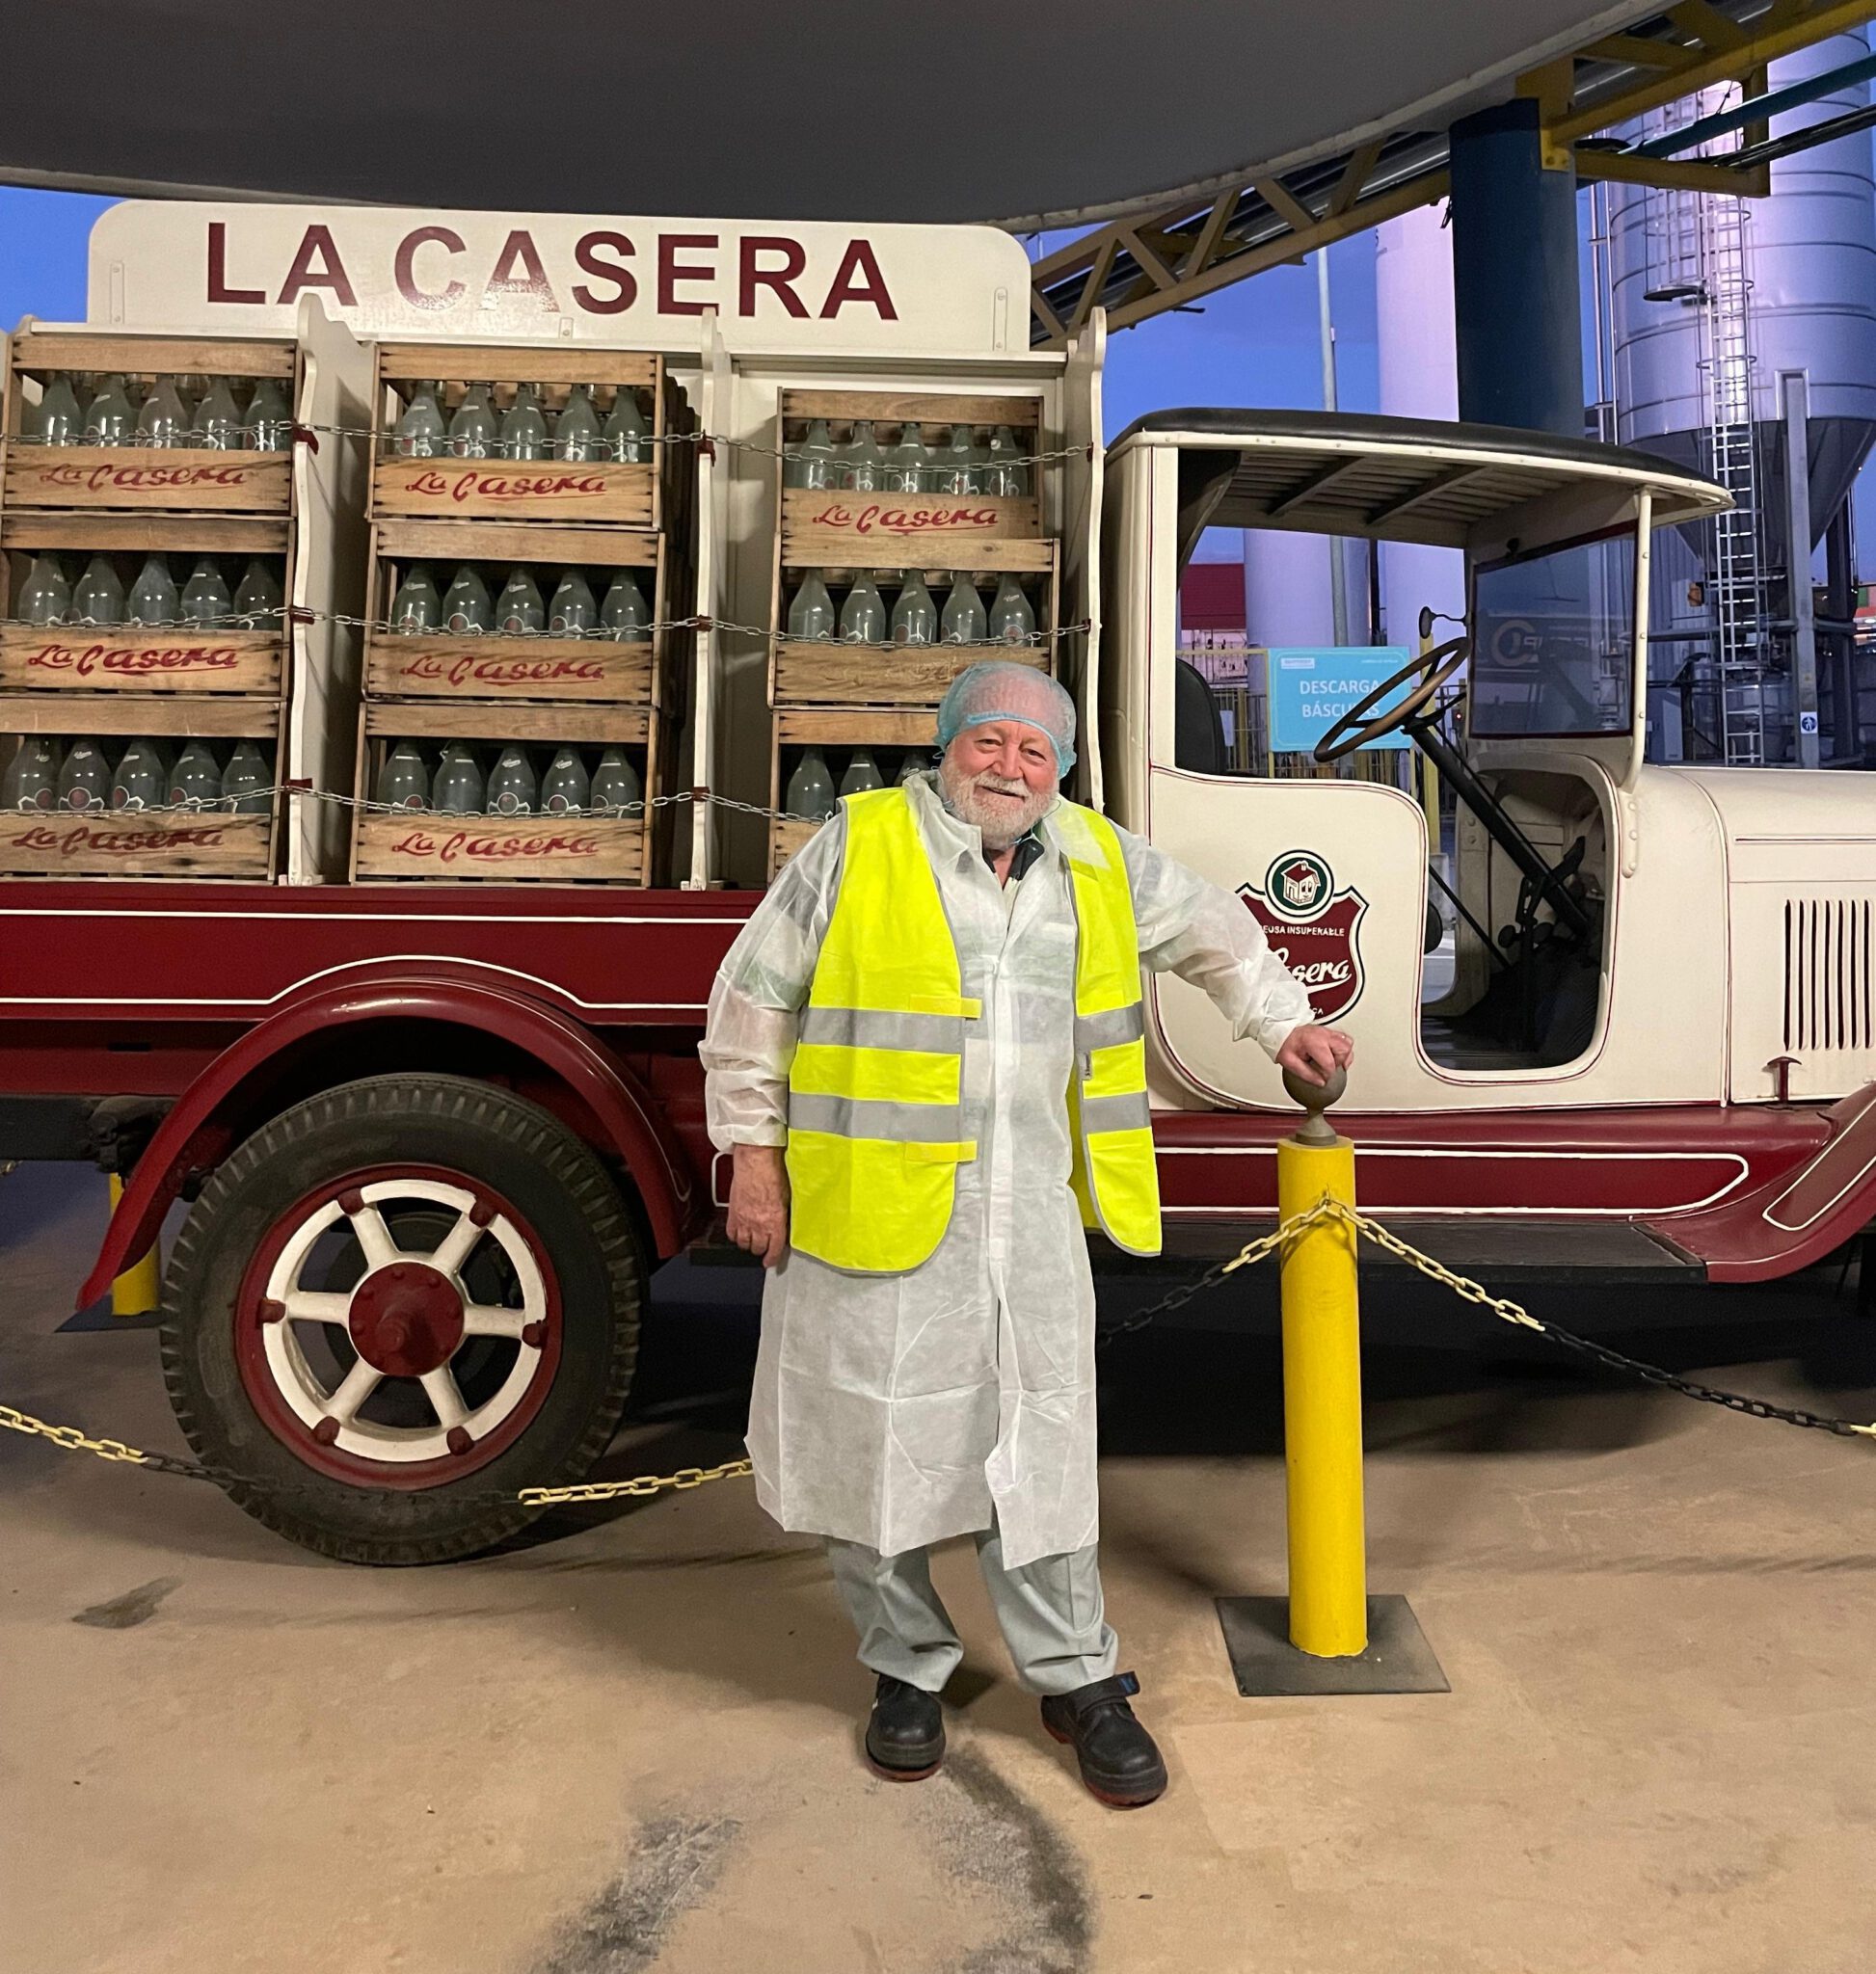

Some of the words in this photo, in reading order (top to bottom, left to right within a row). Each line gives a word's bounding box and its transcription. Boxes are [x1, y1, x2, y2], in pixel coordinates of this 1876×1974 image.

[207, 222, 359, 307] LA
[394, 226, 898, 320] CASERA
[40, 463, 81, 483] La
[87, 464, 247, 493] Casera
[405, 471, 446, 495] La
[452, 472, 607, 503] Casera
[813, 504, 853, 527] La
[856, 505, 999, 536] Casera
[28, 644, 74, 669] La
[76, 644, 240, 677] Casera
[399, 654, 443, 680] La
[447, 655, 605, 686] Casera
[12, 826, 59, 851] La
[60, 826, 225, 857] Casera
[390, 832, 437, 857] La
[439, 832, 601, 864] Casera
[1287, 926, 1345, 937] INSUPERABLE
